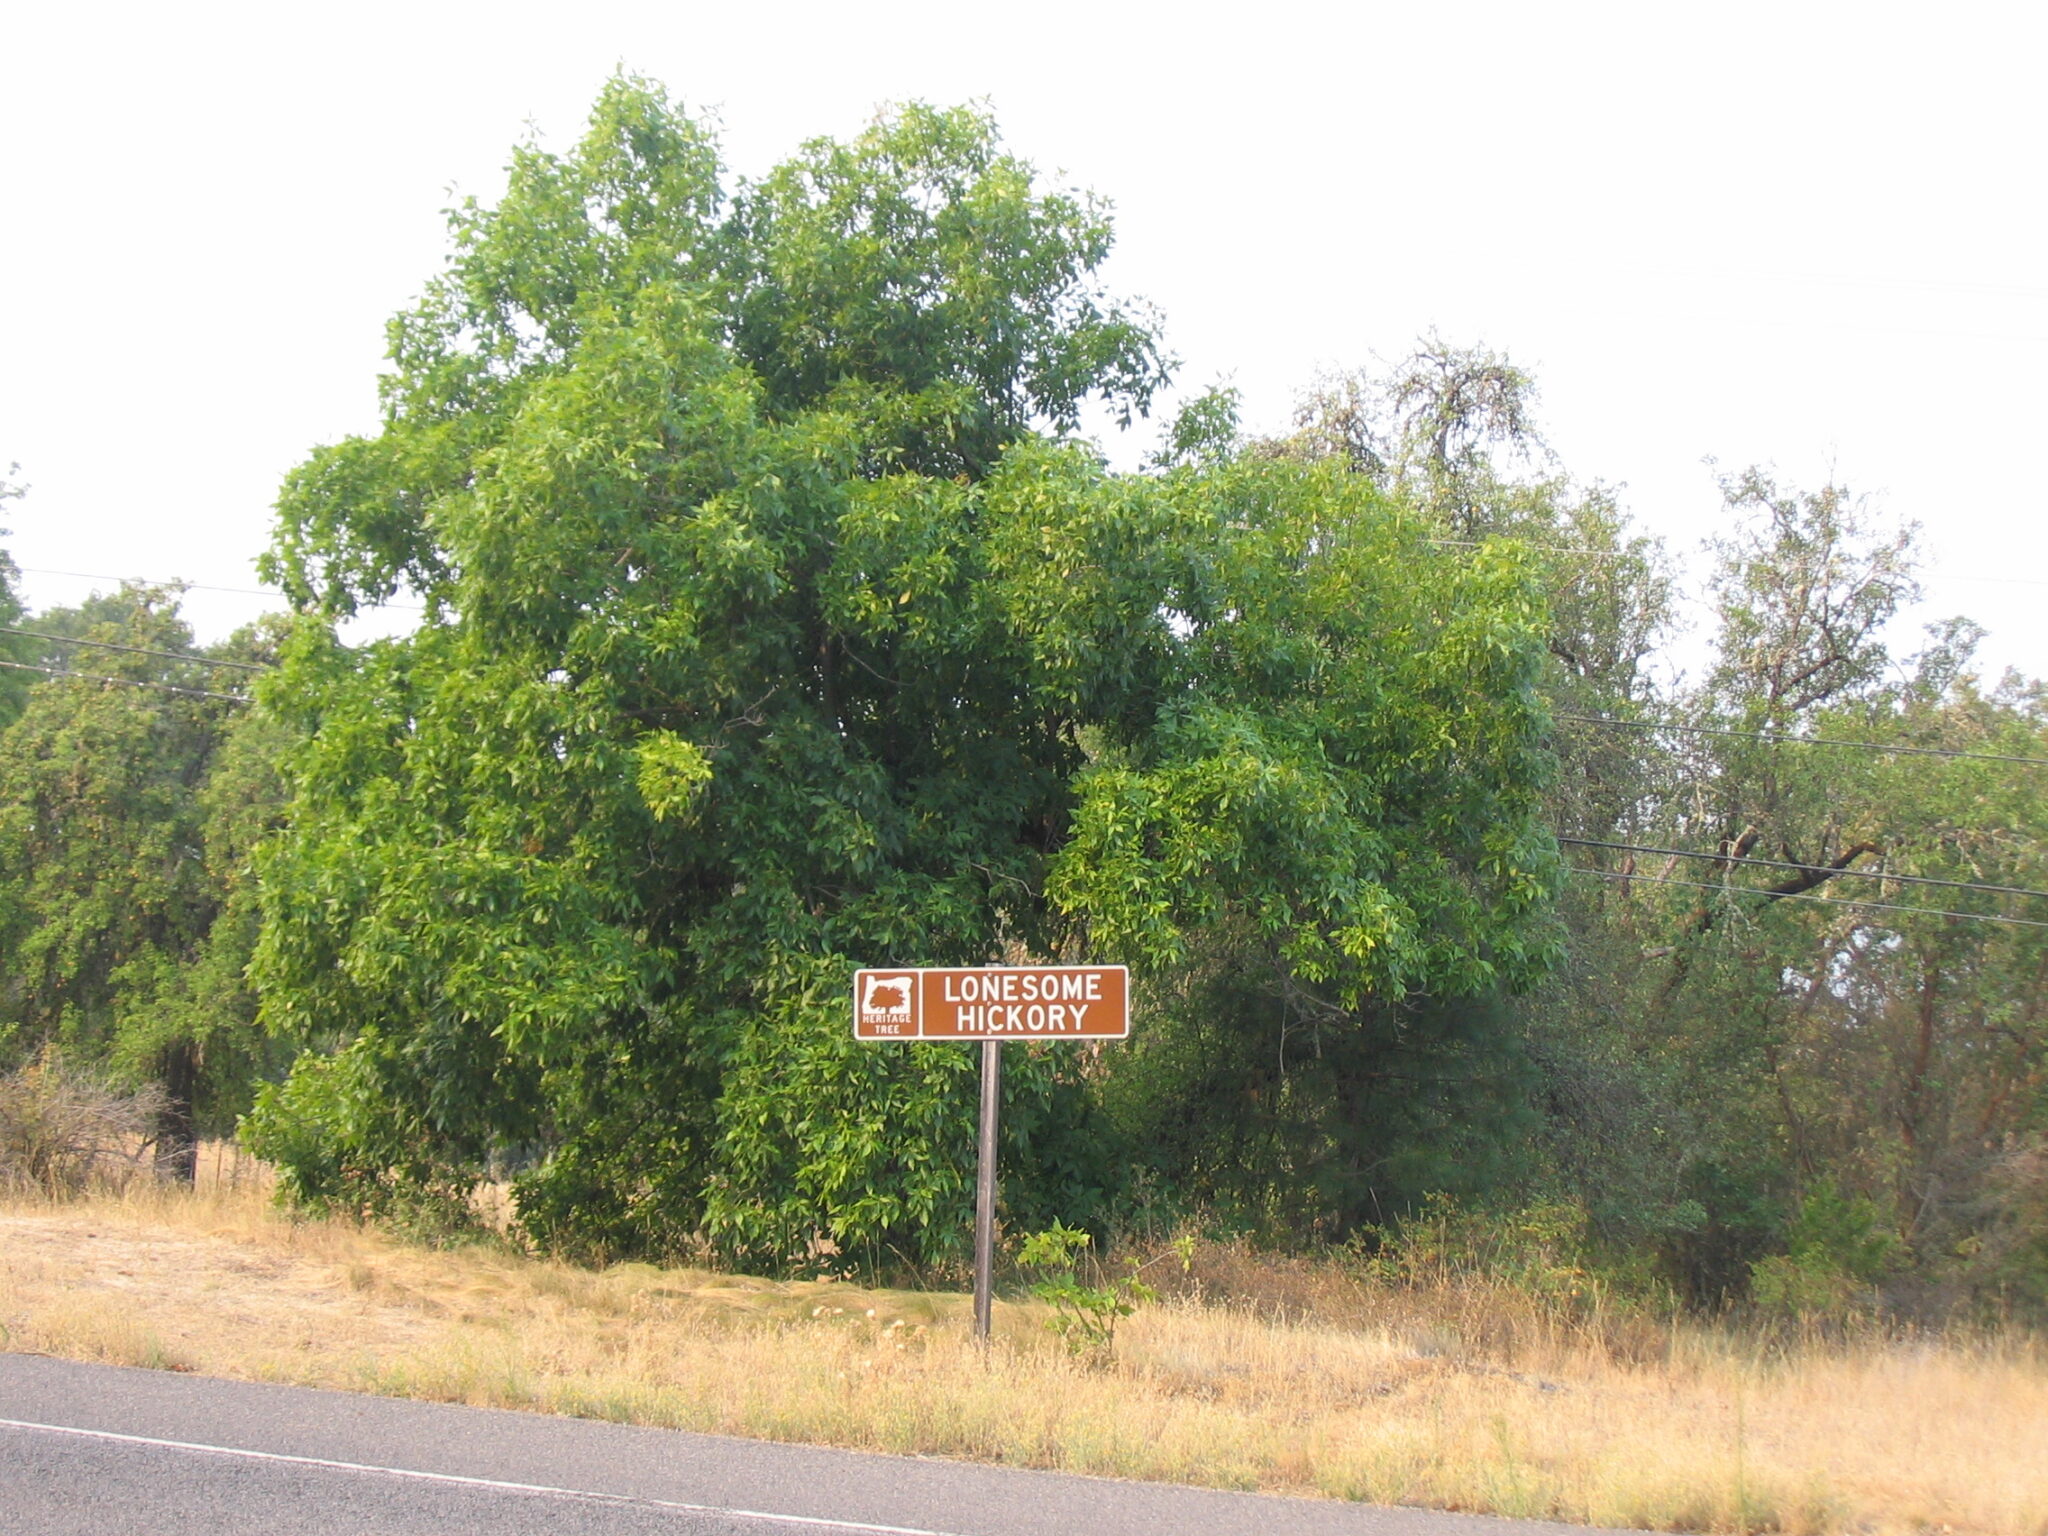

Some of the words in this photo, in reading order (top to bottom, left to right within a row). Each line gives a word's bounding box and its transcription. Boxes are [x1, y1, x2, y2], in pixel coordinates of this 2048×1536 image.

[945, 974, 1102, 1002] LONESOME
[863, 1014, 911, 1023] HERITAGE
[957, 1004, 1088, 1031] HICKORY
[875, 1025, 899, 1034] TREE
